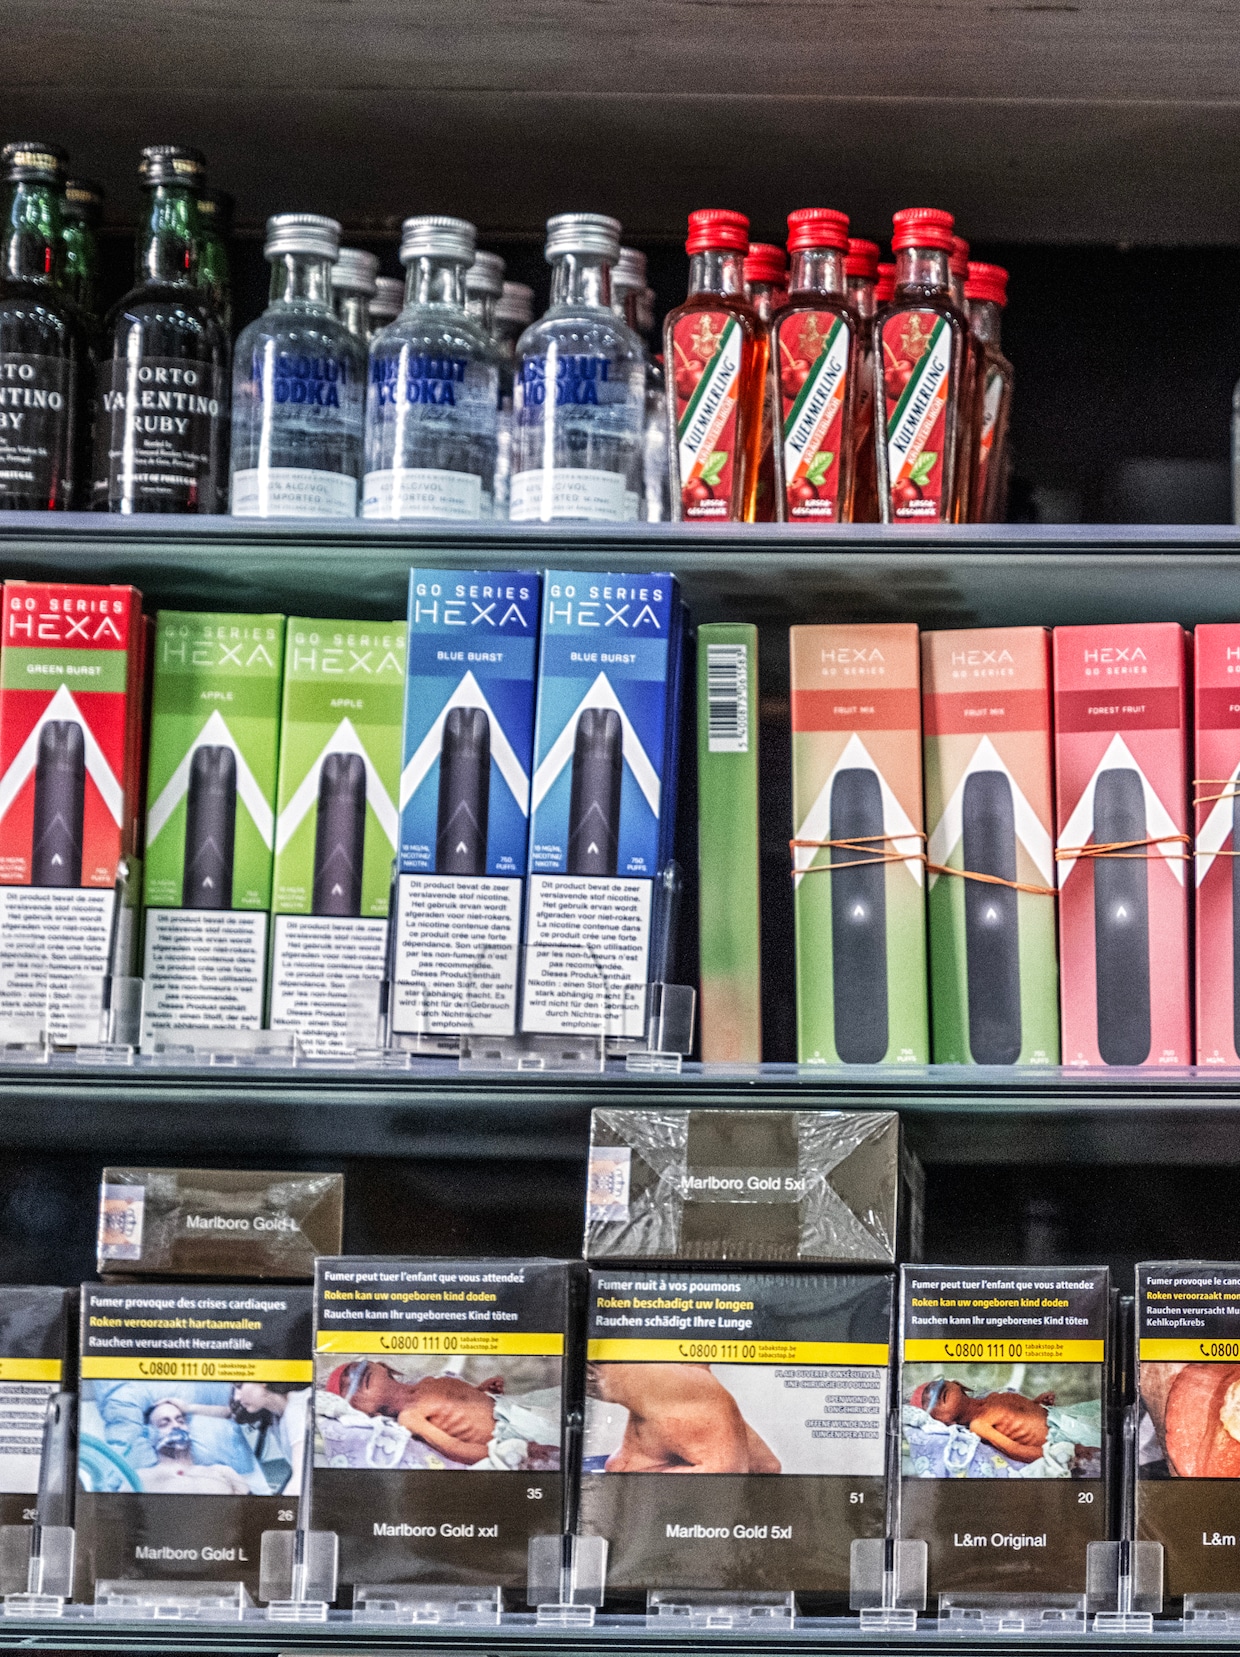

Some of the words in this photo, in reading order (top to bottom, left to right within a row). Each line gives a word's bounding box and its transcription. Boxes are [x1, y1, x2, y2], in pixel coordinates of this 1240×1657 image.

[683, 355, 736, 453] KUEMMERLING
[790, 355, 843, 453] KUEMMERLING
[893, 355, 945, 453] KUEMMERLING
[128, 415, 189, 434] RUBY
[416, 584, 441, 596] GO
[455, 585, 529, 600] SERIES
[551, 585, 575, 597] GO
[590, 586, 663, 601] SERIES
[11, 598, 35, 611] GO
[49, 598, 123, 614] SERIES
[415, 600, 527, 627] HEXA
[550, 601, 660, 628] HEXA
[10, 614, 121, 641] HEXA
[164, 641, 273, 668] HEXA
[437, 650, 464, 661] BLUE
[468, 651, 503, 662] BURST
[570, 652, 598, 662] BLUE
[601, 653, 636, 663] BURST
[1084, 647, 1147, 663] HEXA
[27, 663, 63, 674] GREEN
[66, 665, 101, 675] BURST
[1085, 667, 1103, 676] GO
[1107, 665, 1147, 675] SERIES
[201, 691, 233, 701] APPLE
[1088, 705, 1119, 714] FOREST
[1122, 704, 1145, 713] FRUIT
[681, 1176, 743, 1190] Marlboro
[747, 1176, 780, 1191] Gold
[784, 1177, 805, 1191] 5xl
[597, 1297, 631, 1309] Roken
[633, 1298, 693, 1312] beschadigt
[696, 1301, 712, 1310] uw
[715, 1299, 754, 1312] longen
[527, 1487, 542, 1500] 35
[1077, 1493, 1093, 1504] 20
[373, 1522, 435, 1538] Marlboro
[439, 1522, 472, 1538] Gold
[476, 1523, 498, 1538] xxl
[666, 1523, 730, 1539] Marlboro
[733, 1523, 766, 1539] Gold
[769, 1524, 792, 1539] 5xl
[955, 1533, 988, 1547] L&m
[991, 1533, 1046, 1550] Original
[1203, 1532, 1235, 1546] L&m
